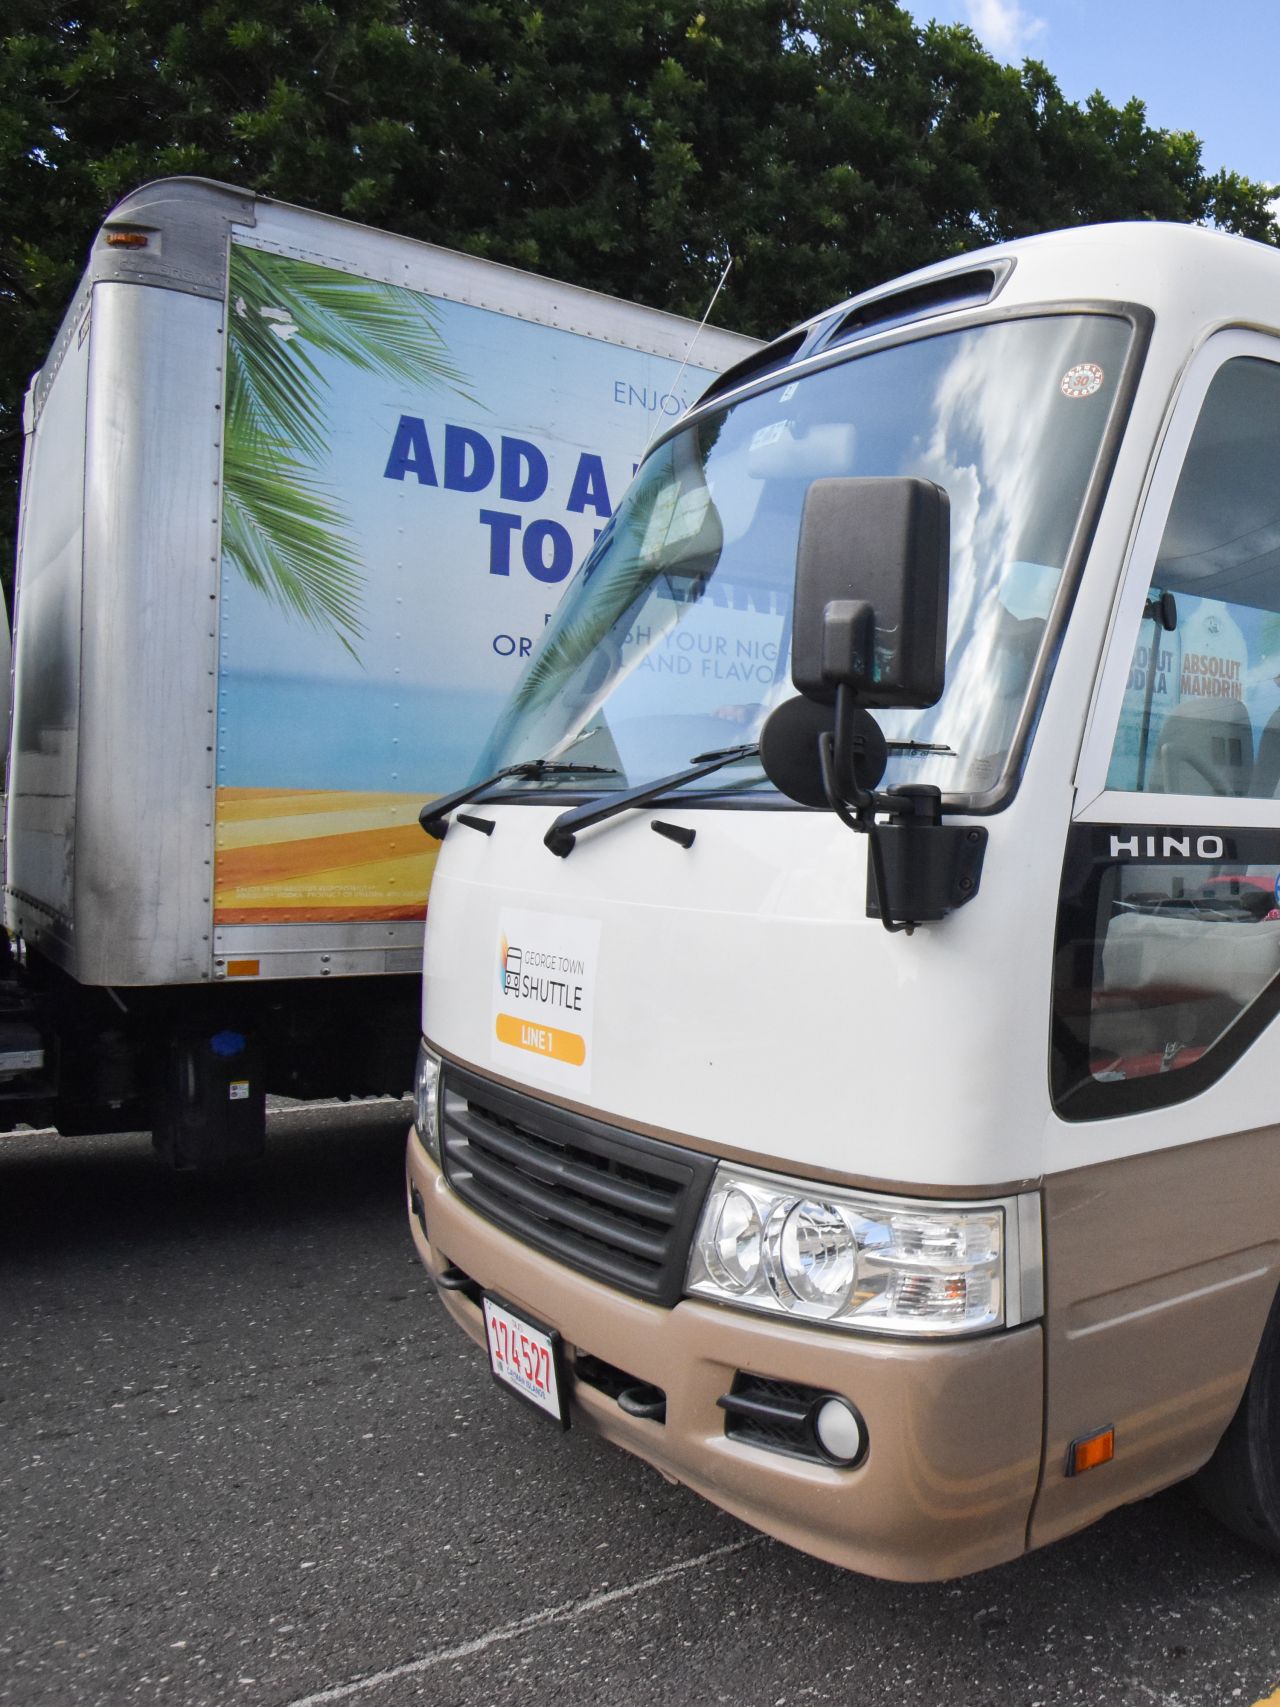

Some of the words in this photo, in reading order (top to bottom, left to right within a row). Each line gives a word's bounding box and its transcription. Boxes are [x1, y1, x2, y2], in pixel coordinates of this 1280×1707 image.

[383, 414, 549, 503] ADD
[566, 452, 613, 519] A
[479, 508, 574, 584] TO
[493, 634, 532, 657] OR
[664, 630, 727, 656] YOUR
[736, 639, 788, 663] NIG
[638, 653, 692, 675] AND
[702, 659, 774, 684] FLAVO
[1183, 653, 1241, 681] ABSOLUT
[1180, 674, 1242, 699] MANDRIN
[1110, 835, 1224, 859] HINO
[525, 950, 557, 970] GEORGE
[558, 957, 584, 976] TOWN
[522, 975, 582, 1011] SHUTTLE
[521, 1025, 546, 1050] LINE
[547, 1032, 553, 1052] 1
